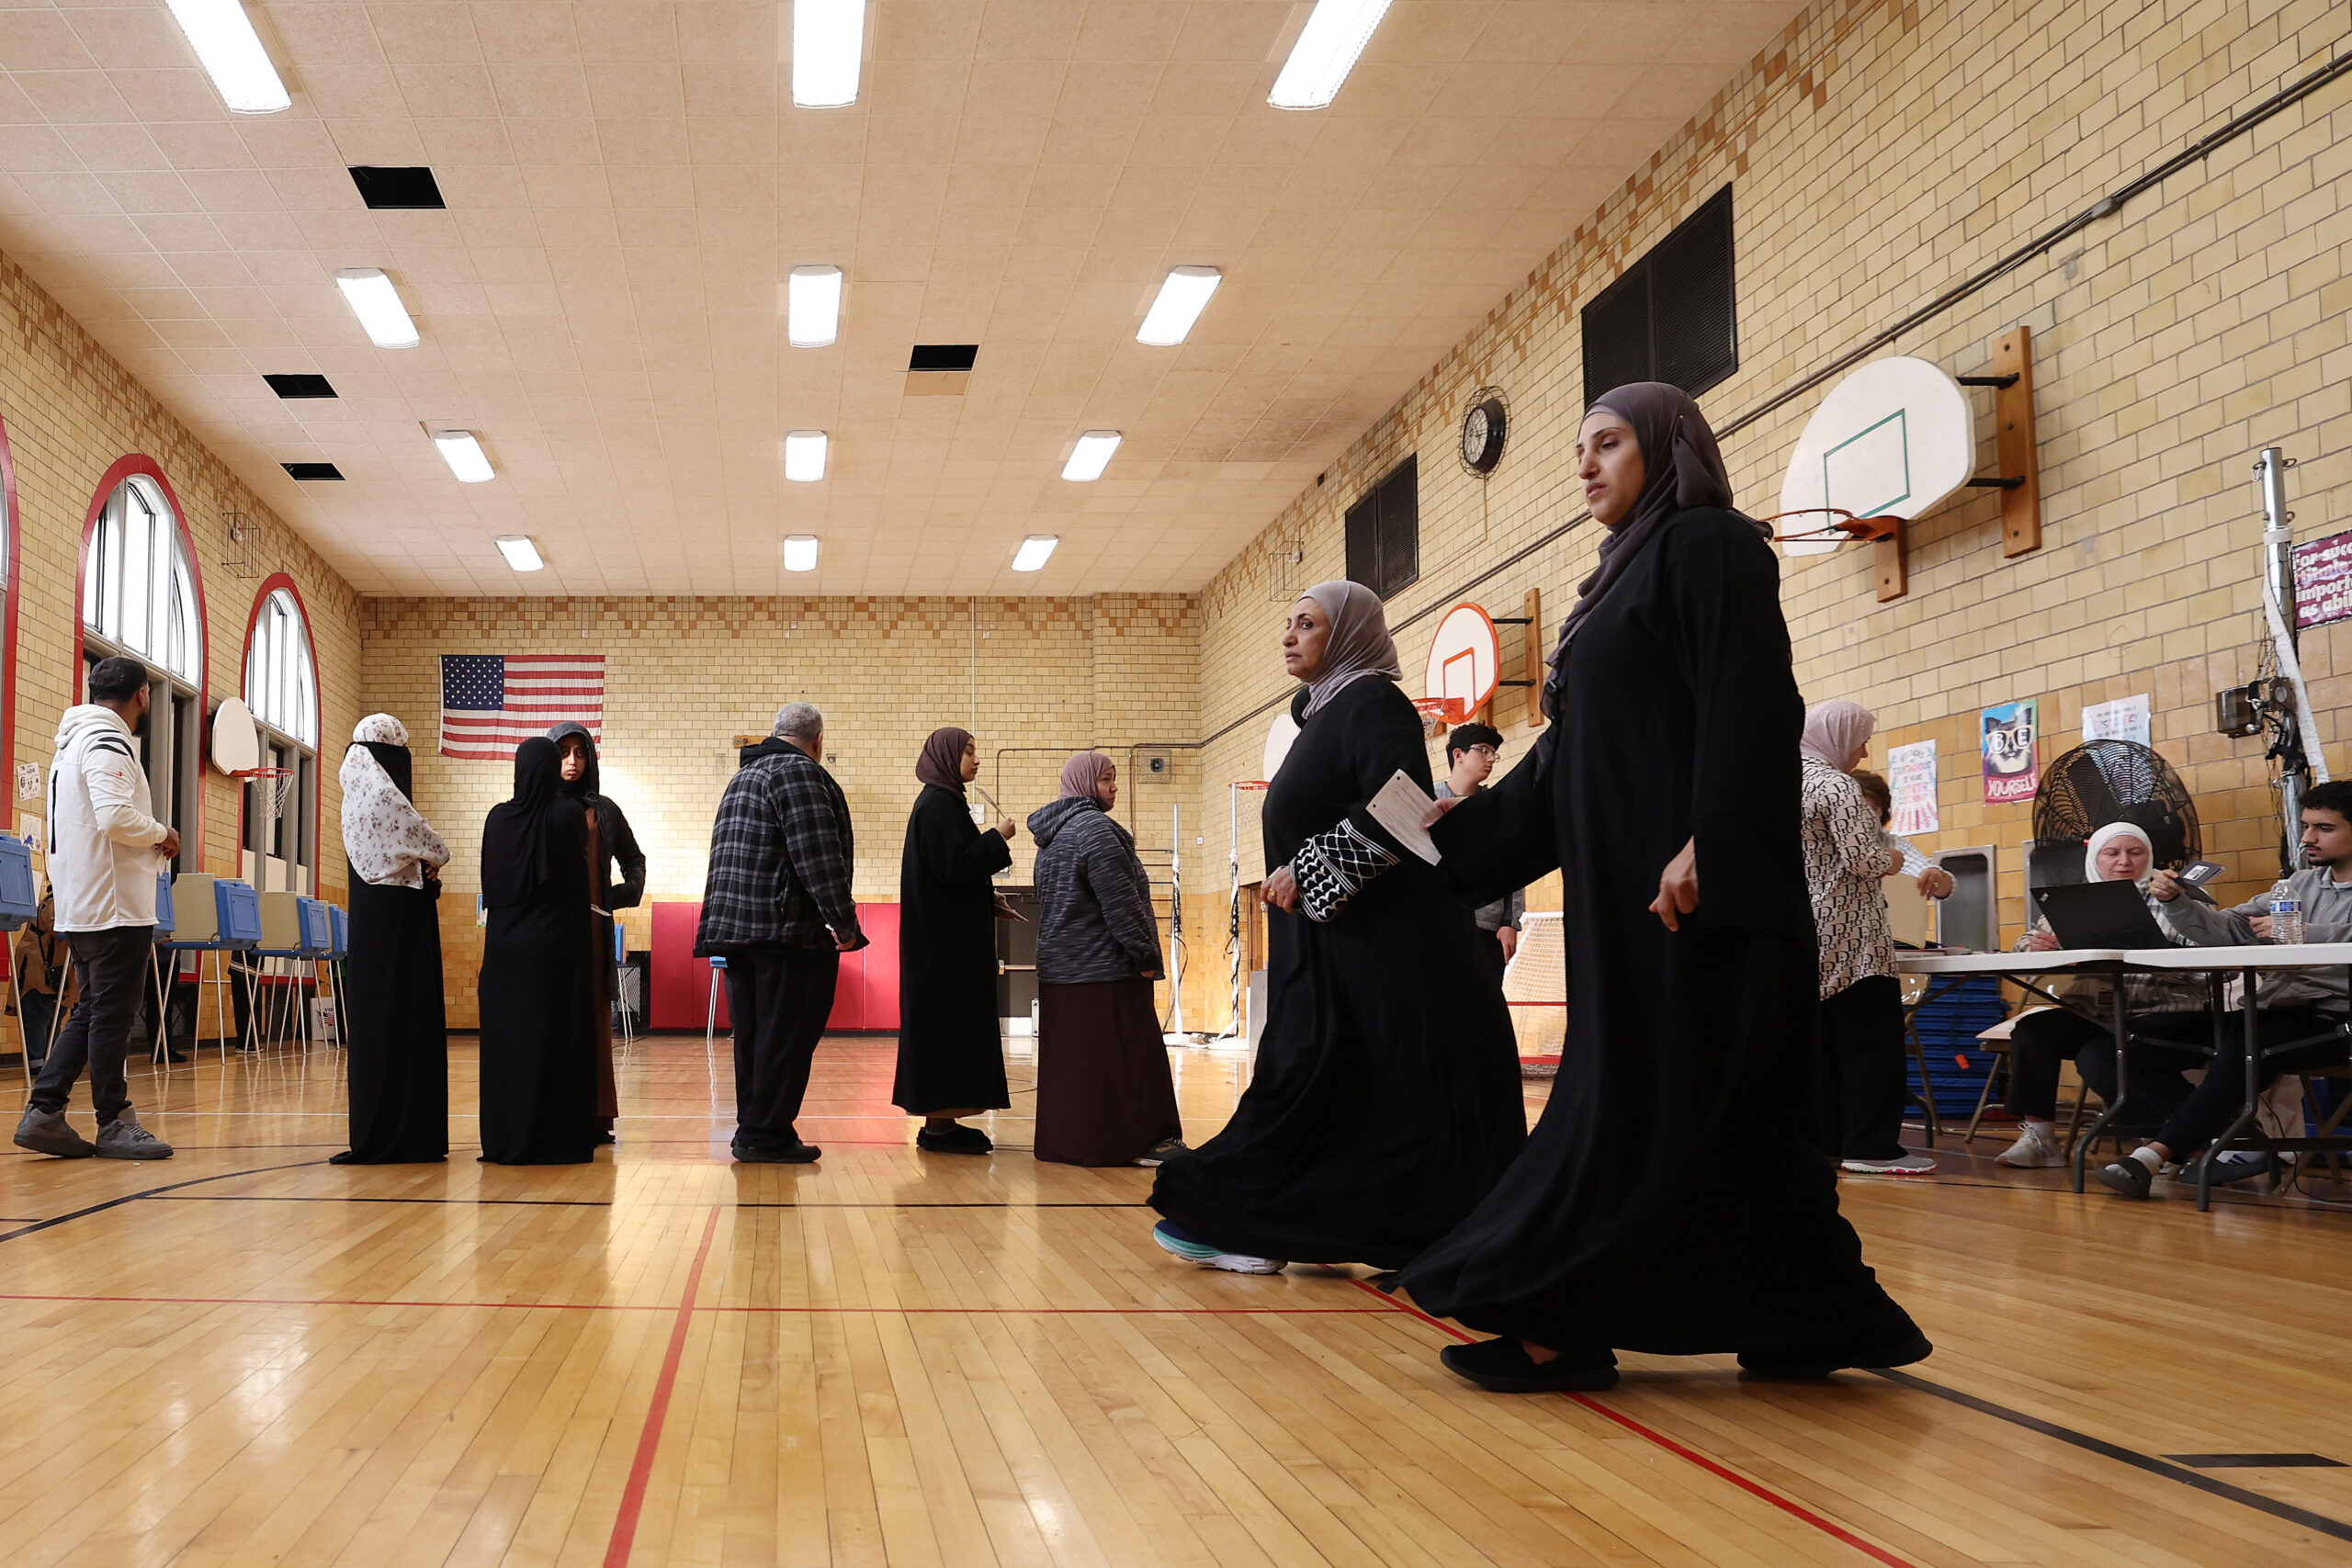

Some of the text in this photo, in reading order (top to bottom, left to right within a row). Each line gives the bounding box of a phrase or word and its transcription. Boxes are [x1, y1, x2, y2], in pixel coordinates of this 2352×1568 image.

[2295, 575, 2352, 603] import
[2299, 604, 2318, 618] as
[1991, 728, 2029, 752] BE
[1987, 773, 2037, 796] YOURSELF
